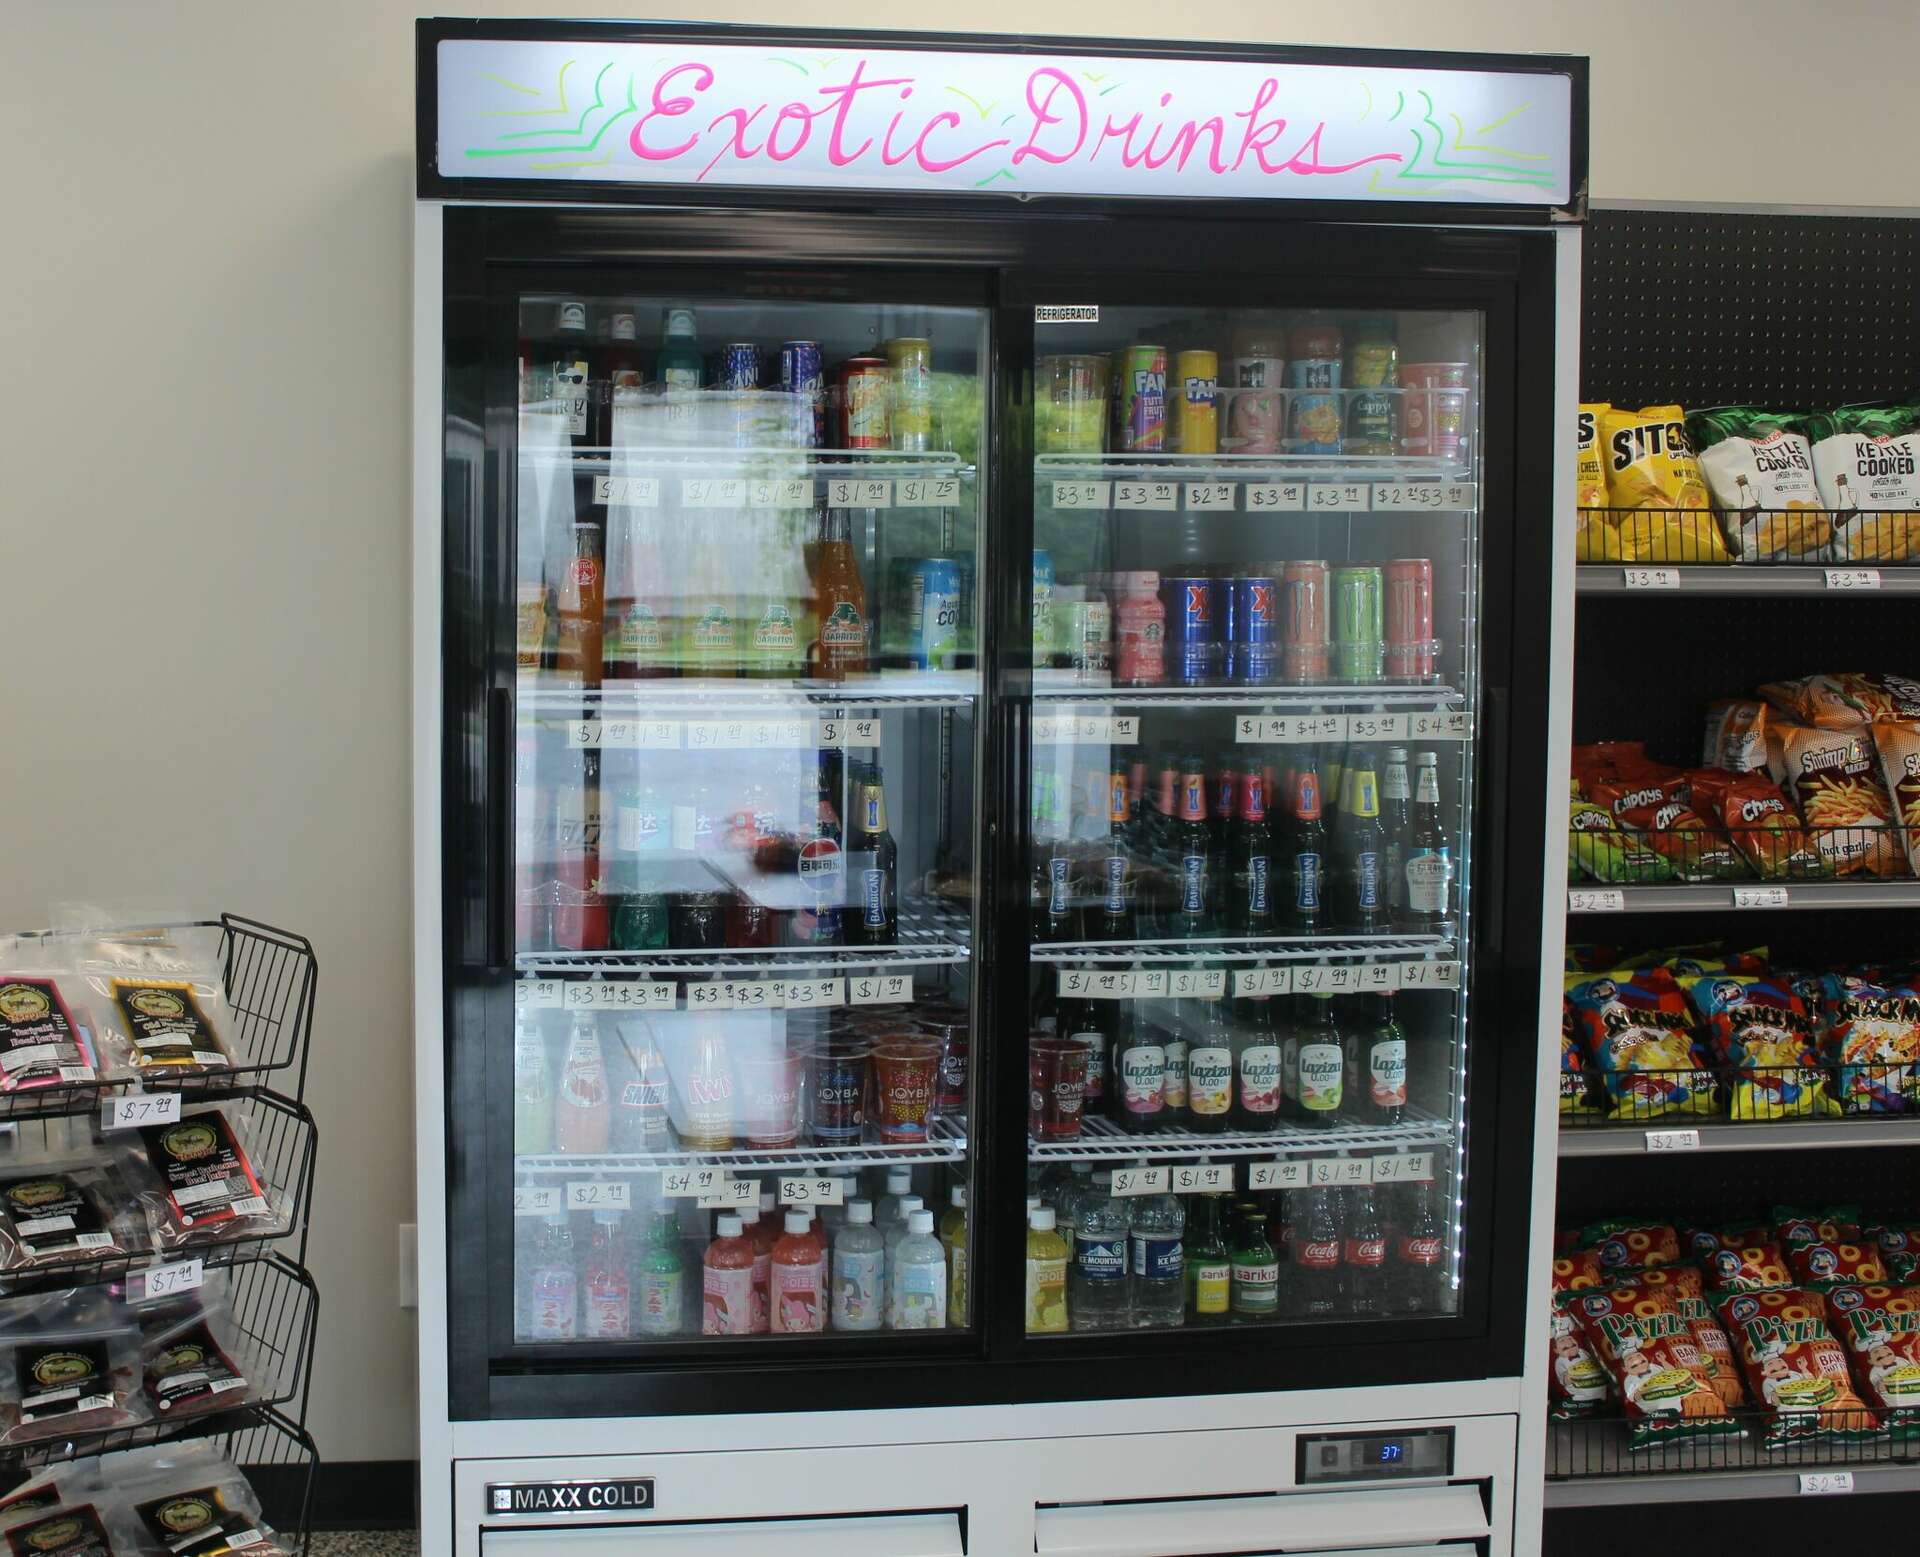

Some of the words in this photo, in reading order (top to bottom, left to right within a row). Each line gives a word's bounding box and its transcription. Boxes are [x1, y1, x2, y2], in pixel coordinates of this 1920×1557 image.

[630, 61, 1010, 184] Exotic
[1011, 65, 1403, 176] Drinks
[1036, 308, 1097, 320] REFRIGERATOR
[1751, 441, 1803, 459] KETTLE
[1856, 442, 1912, 459] KETTLE
[1756, 455, 1810, 472] COOKED
[1857, 458, 1915, 476] COOKED
[836, 484, 884, 502] $1.99
[904, 481, 955, 501] $1.75
[1119, 484, 1171, 504] $3.99
[1191, 486, 1229, 504] $2.99
[1253, 487, 1297, 506] $3.99
[1315, 487, 1359, 504] $3.99
[1628, 572, 1668, 586] $3.99
[1830, 572, 1871, 587] $3.99
[756, 634, 794, 645] JARRITOS
[824, 631, 862, 642] JARRITOS
[1240, 719, 1286, 738] $1.99
[1296, 717, 1337, 735] $4.49
[1354, 717, 1395, 736] $3.99
[1416, 714, 1464, 733] $4.49
[1801, 747, 1848, 774] Shrimp
[1821, 845, 1839, 857] hot
[870, 872, 880, 923] BARBICAN
[1068, 974, 1115, 990] $1.99
[1176, 972, 1220, 992] $1.99
[1243, 970, 1286, 990] $1.99
[1299, 968, 1348, 988] $1.99
[1352, 967, 1388, 988] 1.99
[1406, 965, 1451, 983] $1.99
[569, 984, 615, 1002] $3.99
[620, 986, 669, 1005] $3.99
[694, 984, 733, 1002] $3.9
[788, 982, 834, 1001] $3.99
[857, 978, 903, 998] $1.99
[1124, 1059, 1164, 1078] Laziza
[1189, 1060, 1232, 1078] Laziza
[1241, 1059, 1281, 1076] Laziza
[1301, 1057, 1341, 1074] Laziza
[1135, 1077, 1155, 1086] 0.00
[1199, 1077, 1219, 1087] 0.00
[1253, 1075, 1273, 1085] 0.00
[1311, 1072, 1330, 1082] 0.00
[817, 1087, 859, 1100] JOYBA
[889, 1087, 930, 1100] JOYBA
[120, 1097, 172, 1121] $7.99
[1255, 1165, 1297, 1184] $1.99
[1318, 1163, 1361, 1182] $1.99
[1377, 1158, 1422, 1177] $1.99
[667, 1171, 713, 1191] $4.99
[1115, 1170, 1157, 1190] $1.99
[1179, 1169, 1219, 1187] $1.99
[575, 1185, 623, 1203] $2.99
[783, 1181, 831, 1199] $3.99
[1093, 1253, 1124, 1265] MOUNTAIN
[1158, 1256, 1169, 1266] ICE
[152, 1265, 192, 1292] $7.99
[516, 1487, 581, 1509] MAXX
[588, 1485, 648, 1506] COLD
